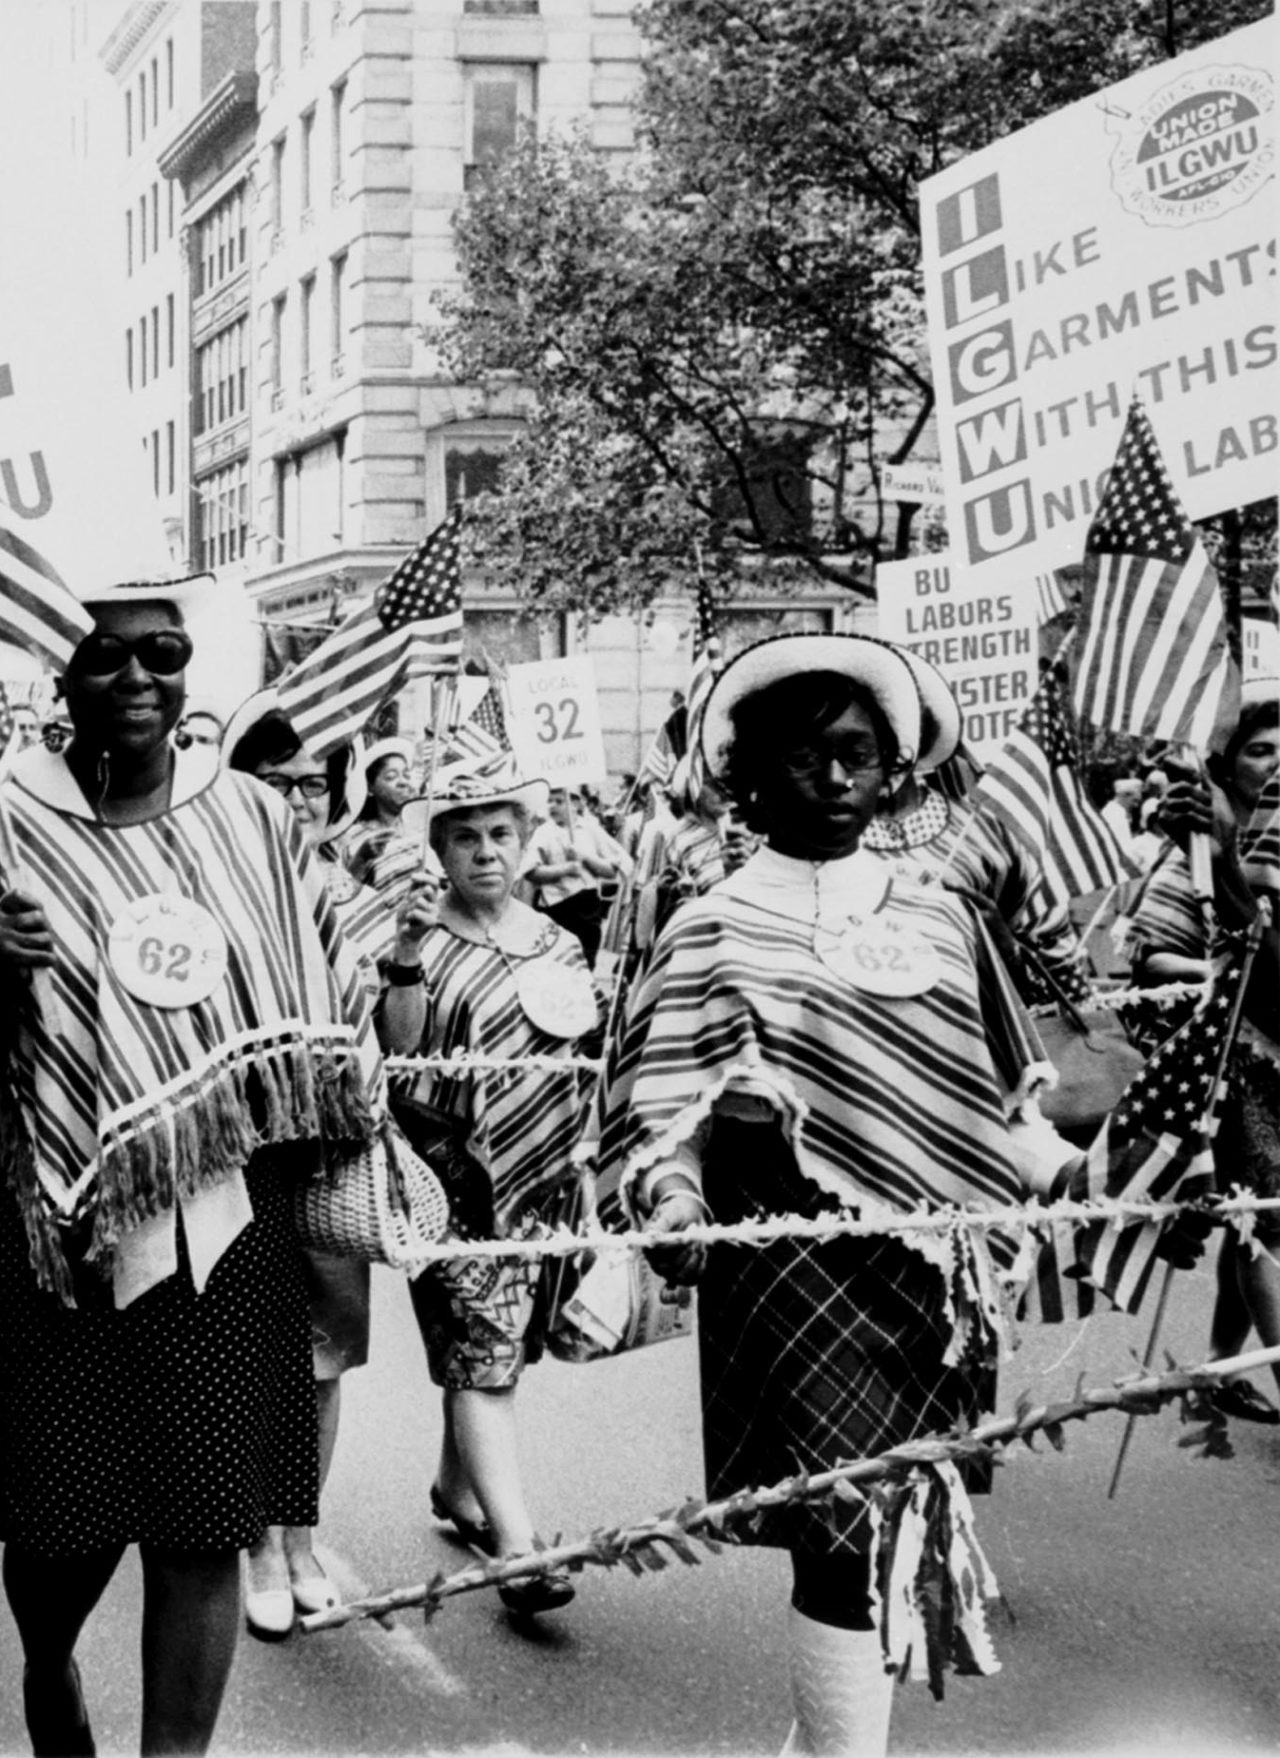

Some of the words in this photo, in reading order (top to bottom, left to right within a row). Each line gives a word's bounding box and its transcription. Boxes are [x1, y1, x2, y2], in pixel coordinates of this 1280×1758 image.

[1150, 93, 1237, 139] UNION
[1159, 111, 1235, 152] MADE
[1145, 125, 1259, 192] ILGWU
[1138, 324, 1277, 403] THIS
[906, 595, 1013, 634] LABORS
[907, 627, 1030, 666] TRENGTH
[949, 670, 1029, 708] ISTER
[534, 697, 585, 744] 32
[967, 708, 1018, 743] OTE
[138, 936, 192, 982] 62
[853, 943, 910, 973] 62
